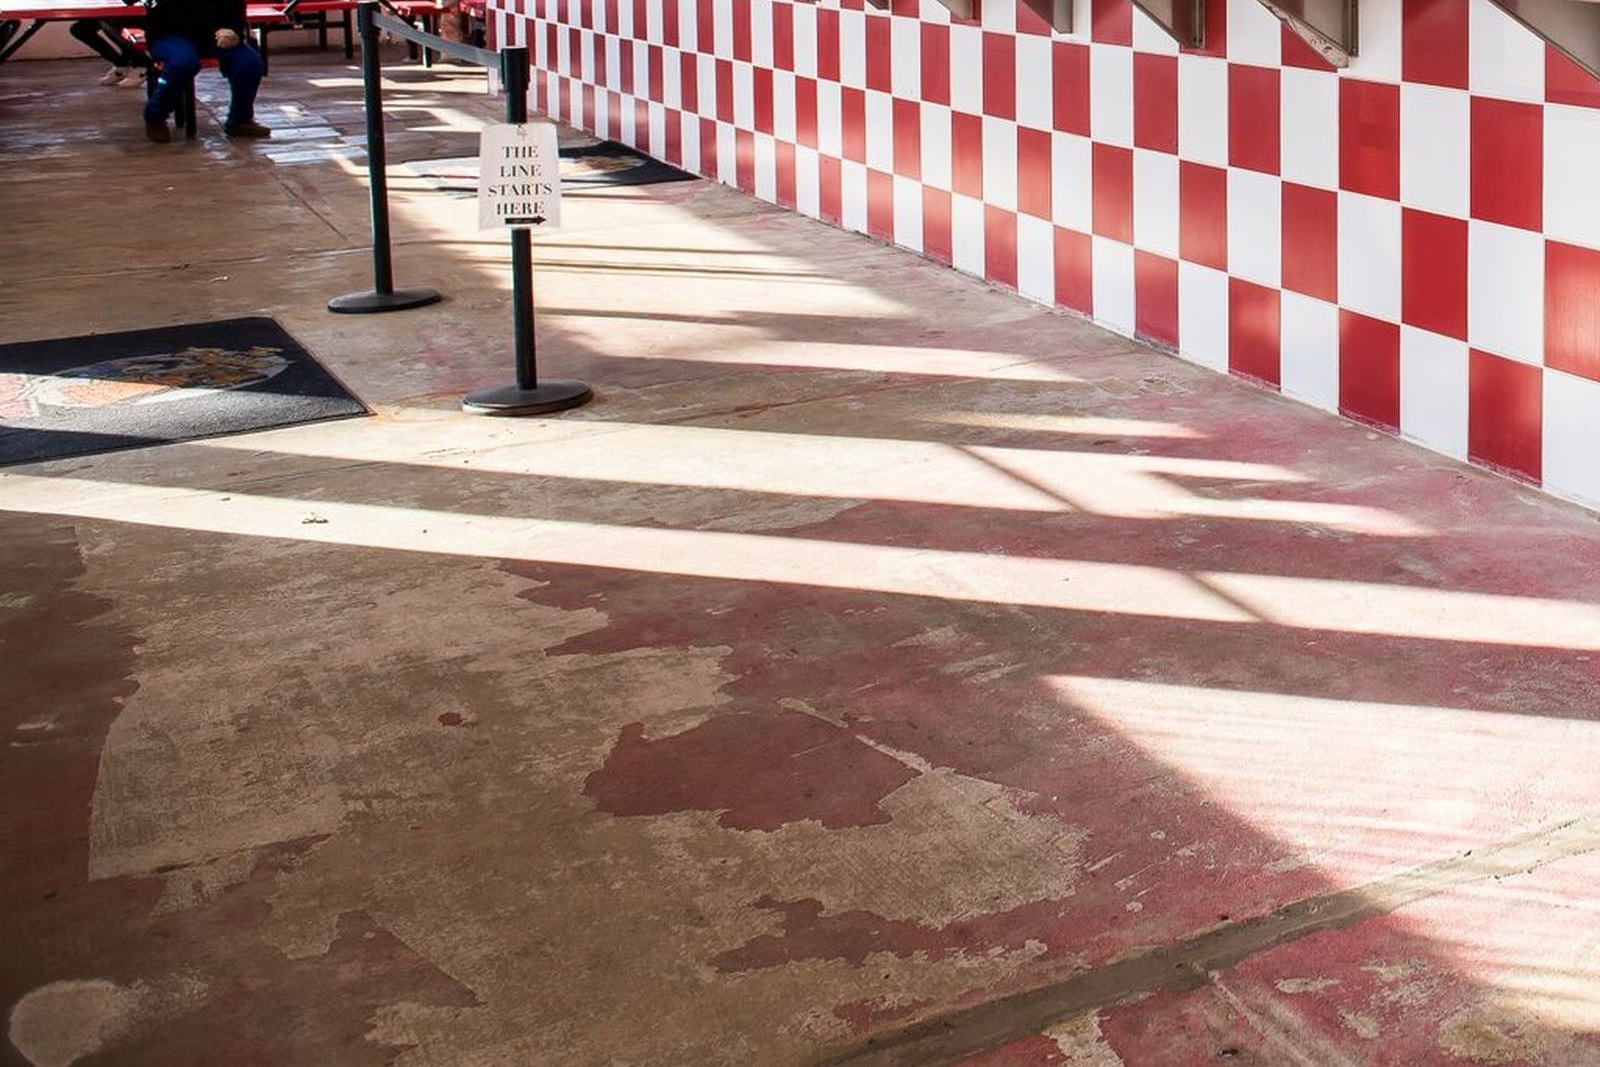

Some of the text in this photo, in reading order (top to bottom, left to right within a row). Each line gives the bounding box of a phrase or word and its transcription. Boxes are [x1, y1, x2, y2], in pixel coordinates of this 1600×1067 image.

[502, 145, 538, 159] THE
[500, 164, 542, 178] LINE
[488, 182, 553, 198] STARTS
[496, 200, 545, 215] HERE
